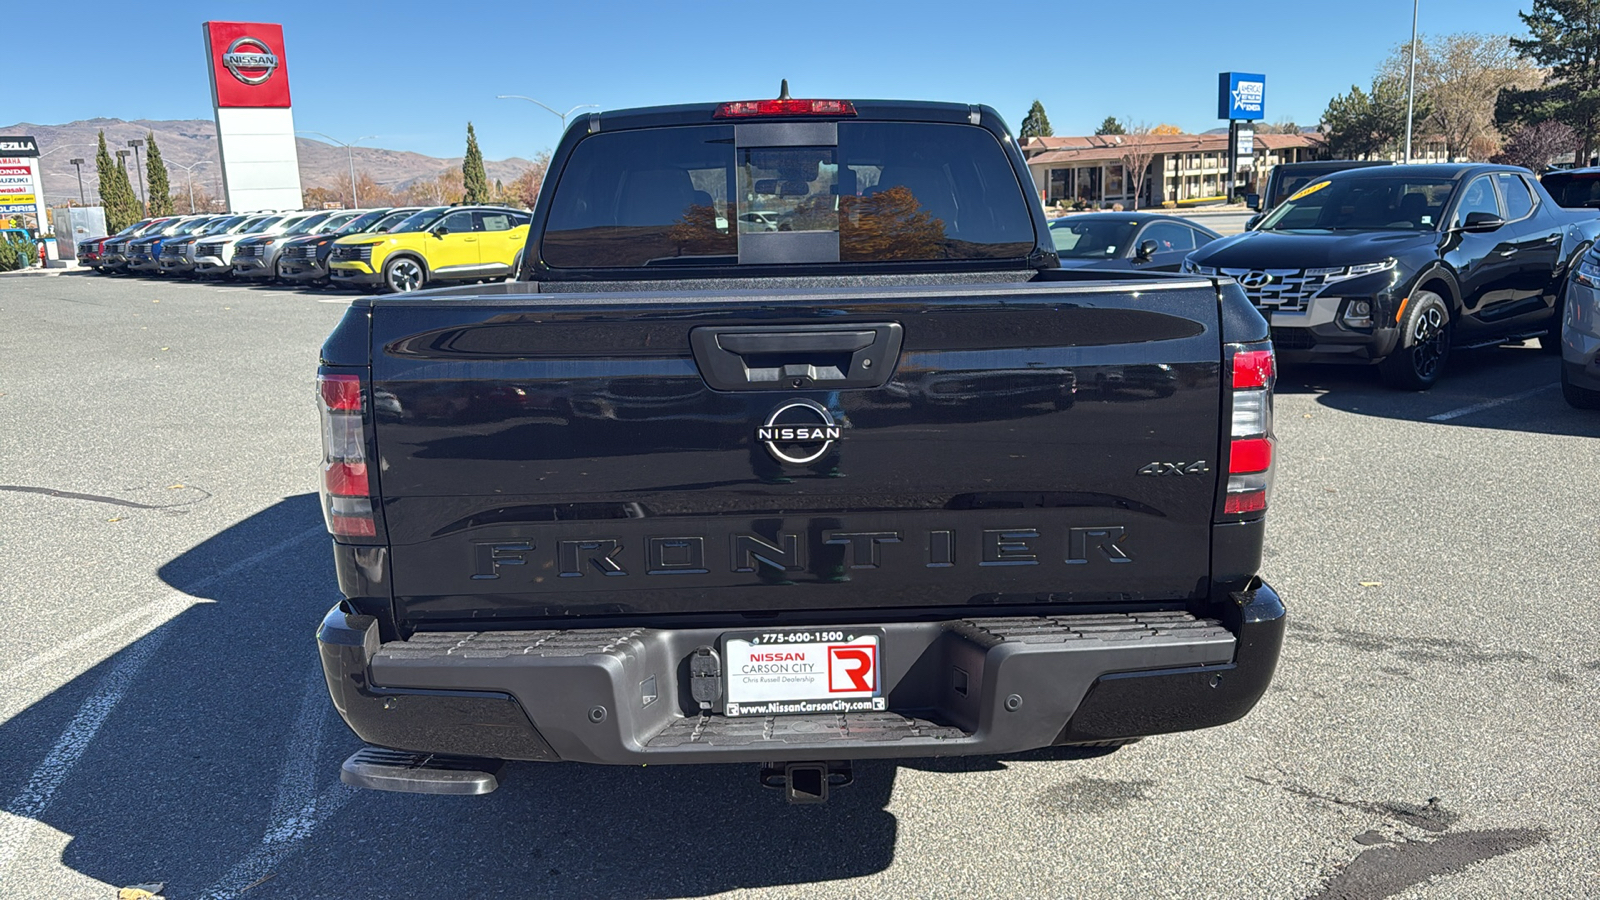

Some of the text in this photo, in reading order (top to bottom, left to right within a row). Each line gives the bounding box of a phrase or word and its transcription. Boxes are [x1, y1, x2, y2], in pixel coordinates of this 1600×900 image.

[229, 56, 274, 64] NISSAN
[759, 428, 839, 439] NISSAN
[469, 526, 1133, 580] FRONTIER
[762, 632, 843, 643] 775-600-1500
[750, 653, 805, 662] NISSAN
[742, 663, 815, 674] CARSON CITY
[782, 675, 815, 684] Dealership
[740, 700, 872, 714] www.NissanCarsonCity.com
